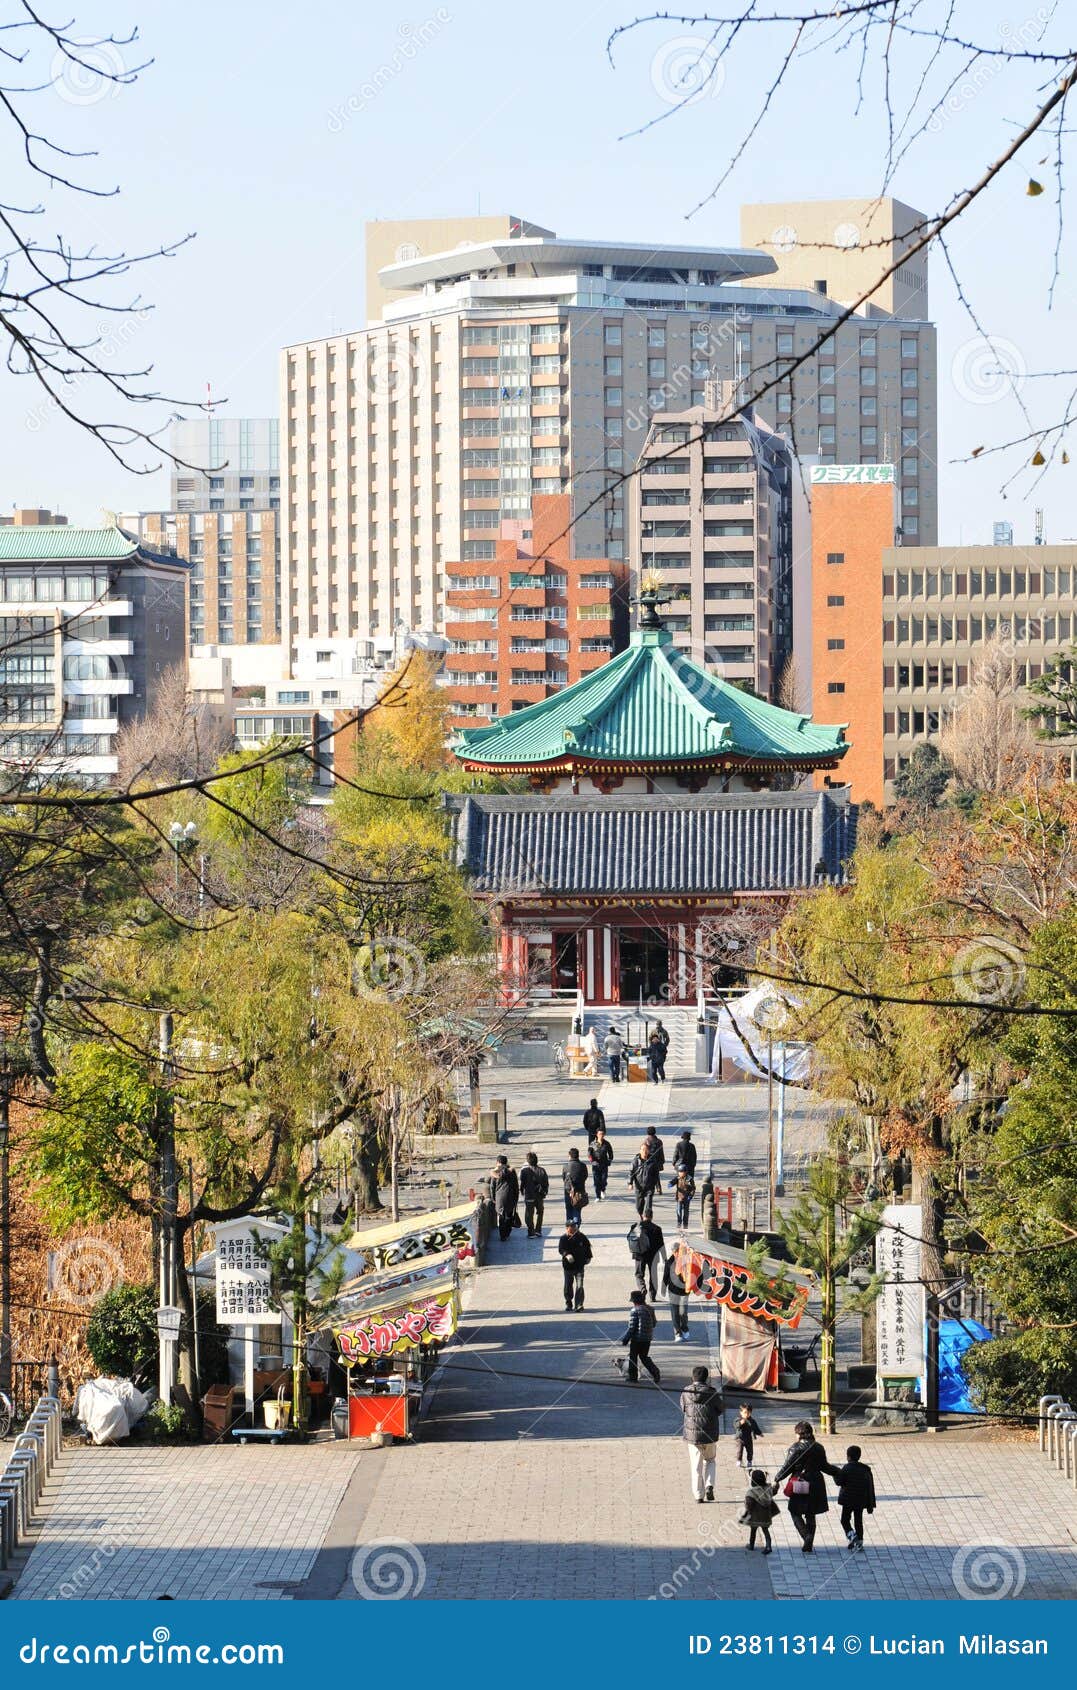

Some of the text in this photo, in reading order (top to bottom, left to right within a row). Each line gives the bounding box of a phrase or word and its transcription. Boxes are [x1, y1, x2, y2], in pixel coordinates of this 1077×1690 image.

[813, 467, 892, 481] クミアイ化学
[228, 1239, 236, 1270] 五月八日
[236, 1239, 244, 1269] 四月二日
[375, 1223, 471, 1267] たこやき
[338, 1303, 453, 1361] いかやき
